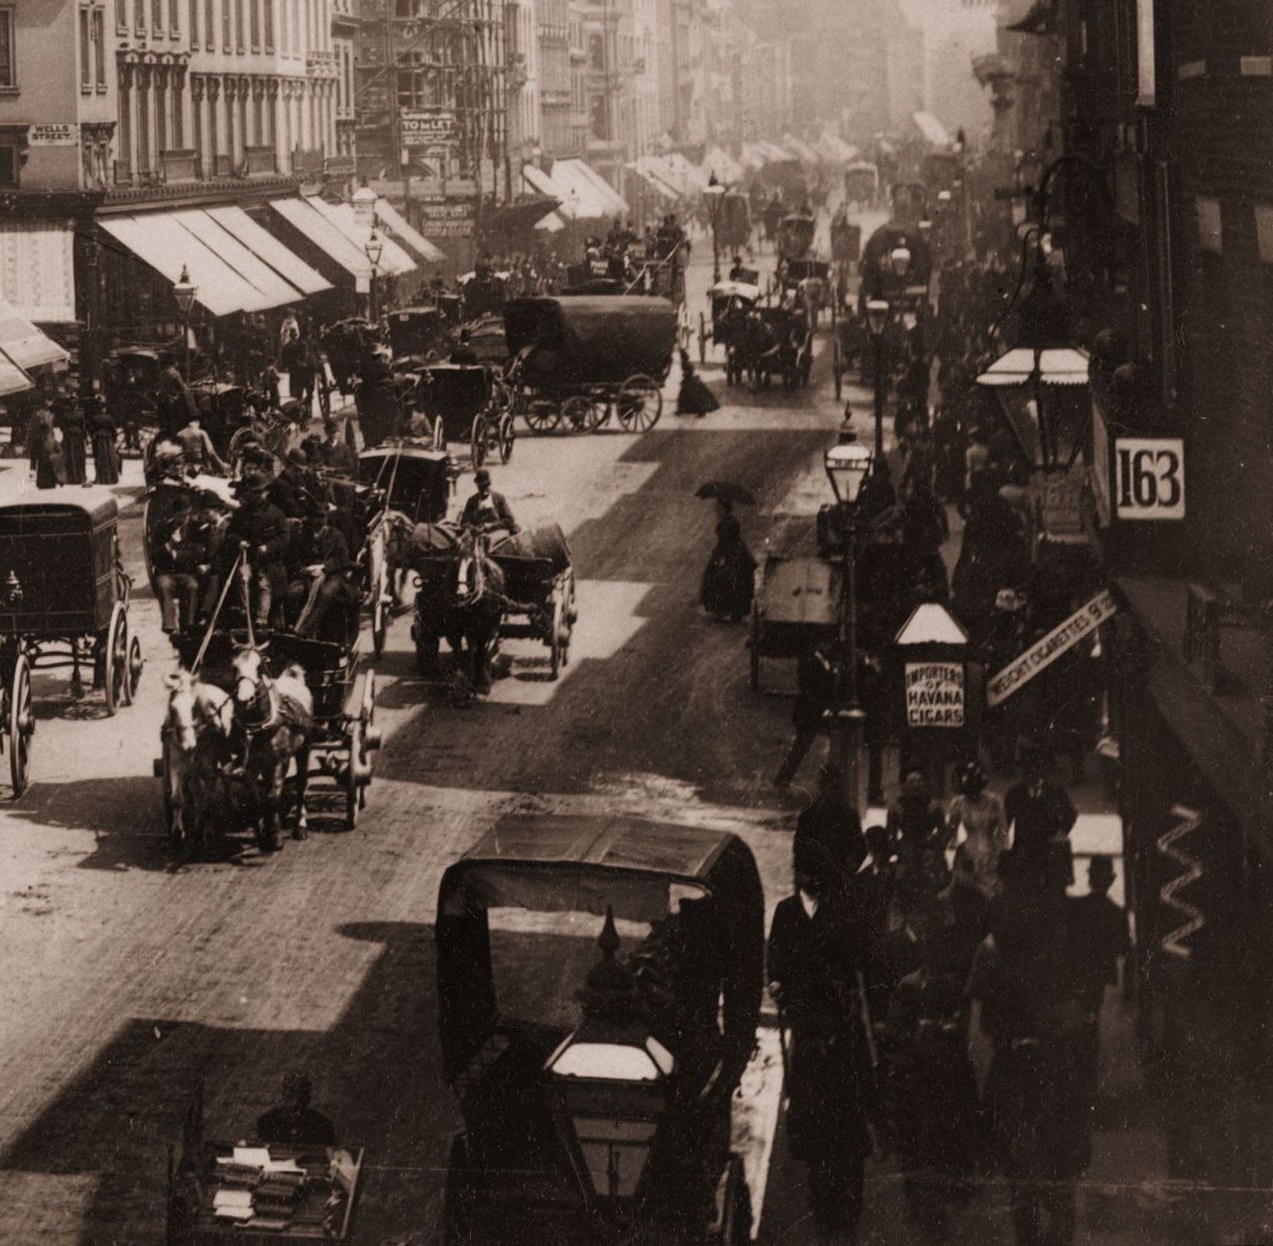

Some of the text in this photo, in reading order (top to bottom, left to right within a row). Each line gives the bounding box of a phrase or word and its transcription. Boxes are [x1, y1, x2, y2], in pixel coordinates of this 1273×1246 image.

[35, 125, 69, 133] WELLS
[1117, 448, 1182, 509] 163
[908, 690, 963, 706] HAVANA
[909, 708, 964, 724] CIGARS
